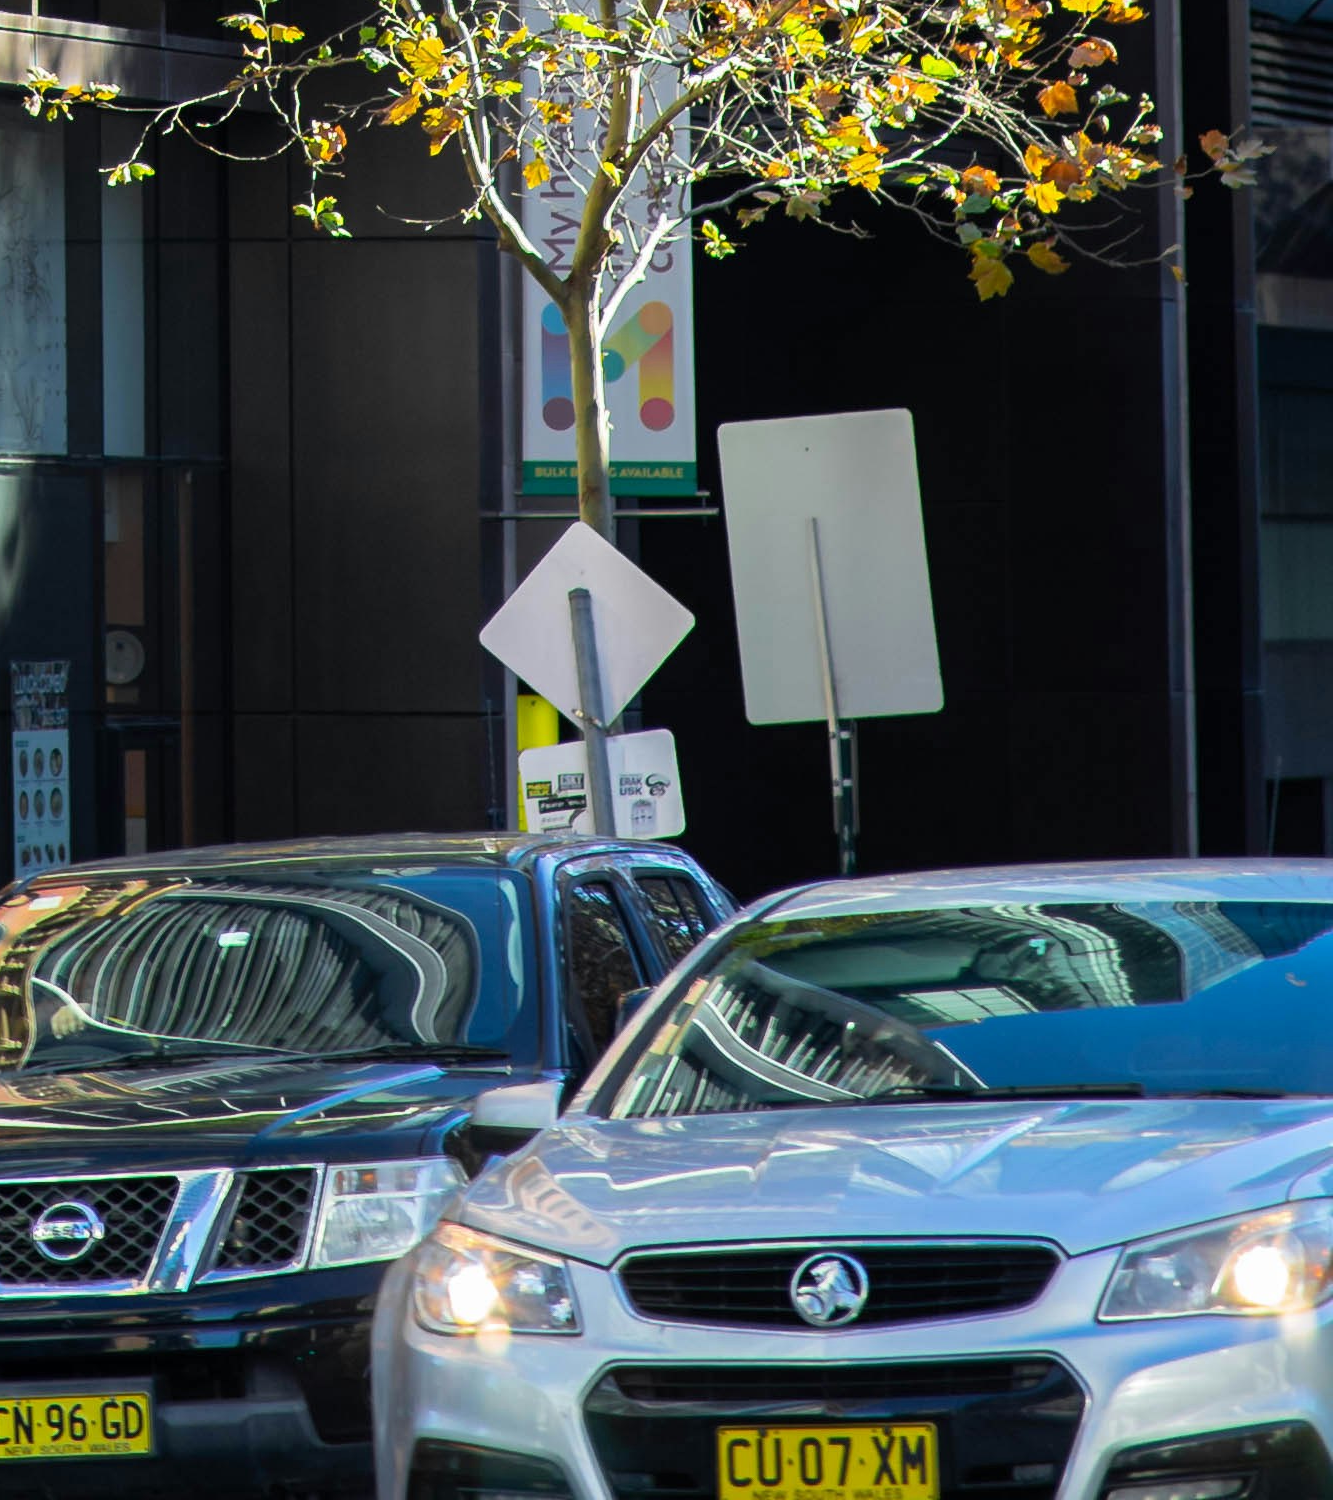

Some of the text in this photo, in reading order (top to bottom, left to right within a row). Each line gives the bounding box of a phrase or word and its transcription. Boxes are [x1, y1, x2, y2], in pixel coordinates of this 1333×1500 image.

[619, 467, 684, 479] AVAILABLE
[4, 1441, 131, 1456] NEW SOUTH WALES
